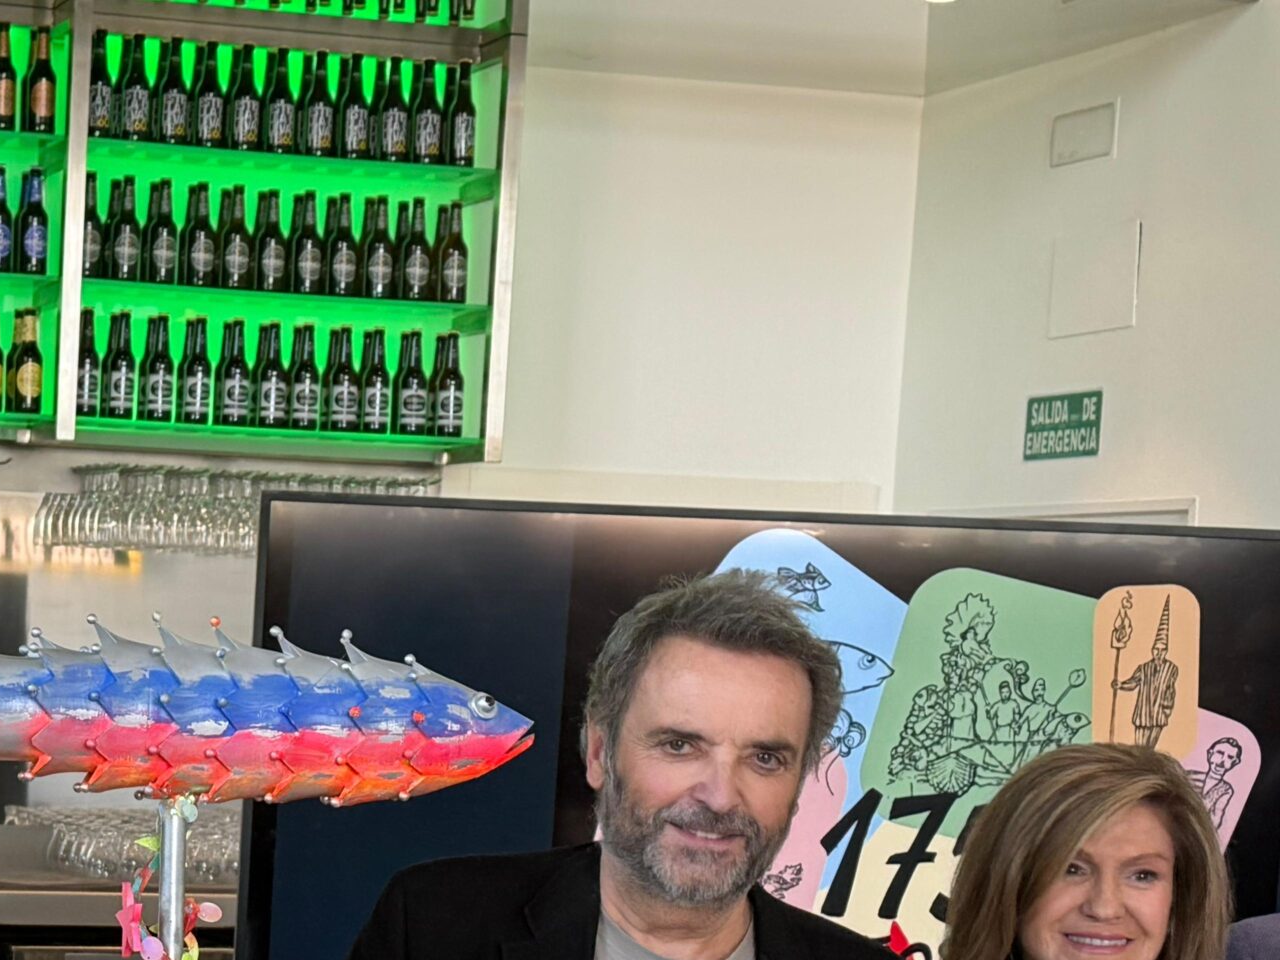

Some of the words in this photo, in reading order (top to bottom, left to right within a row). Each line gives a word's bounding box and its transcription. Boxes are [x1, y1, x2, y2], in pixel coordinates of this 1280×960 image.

[1030, 399, 1069, 427] SALIDA
[1081, 396, 1098, 422] DE
[1025, 426, 1097, 455] EMERGENCIA
